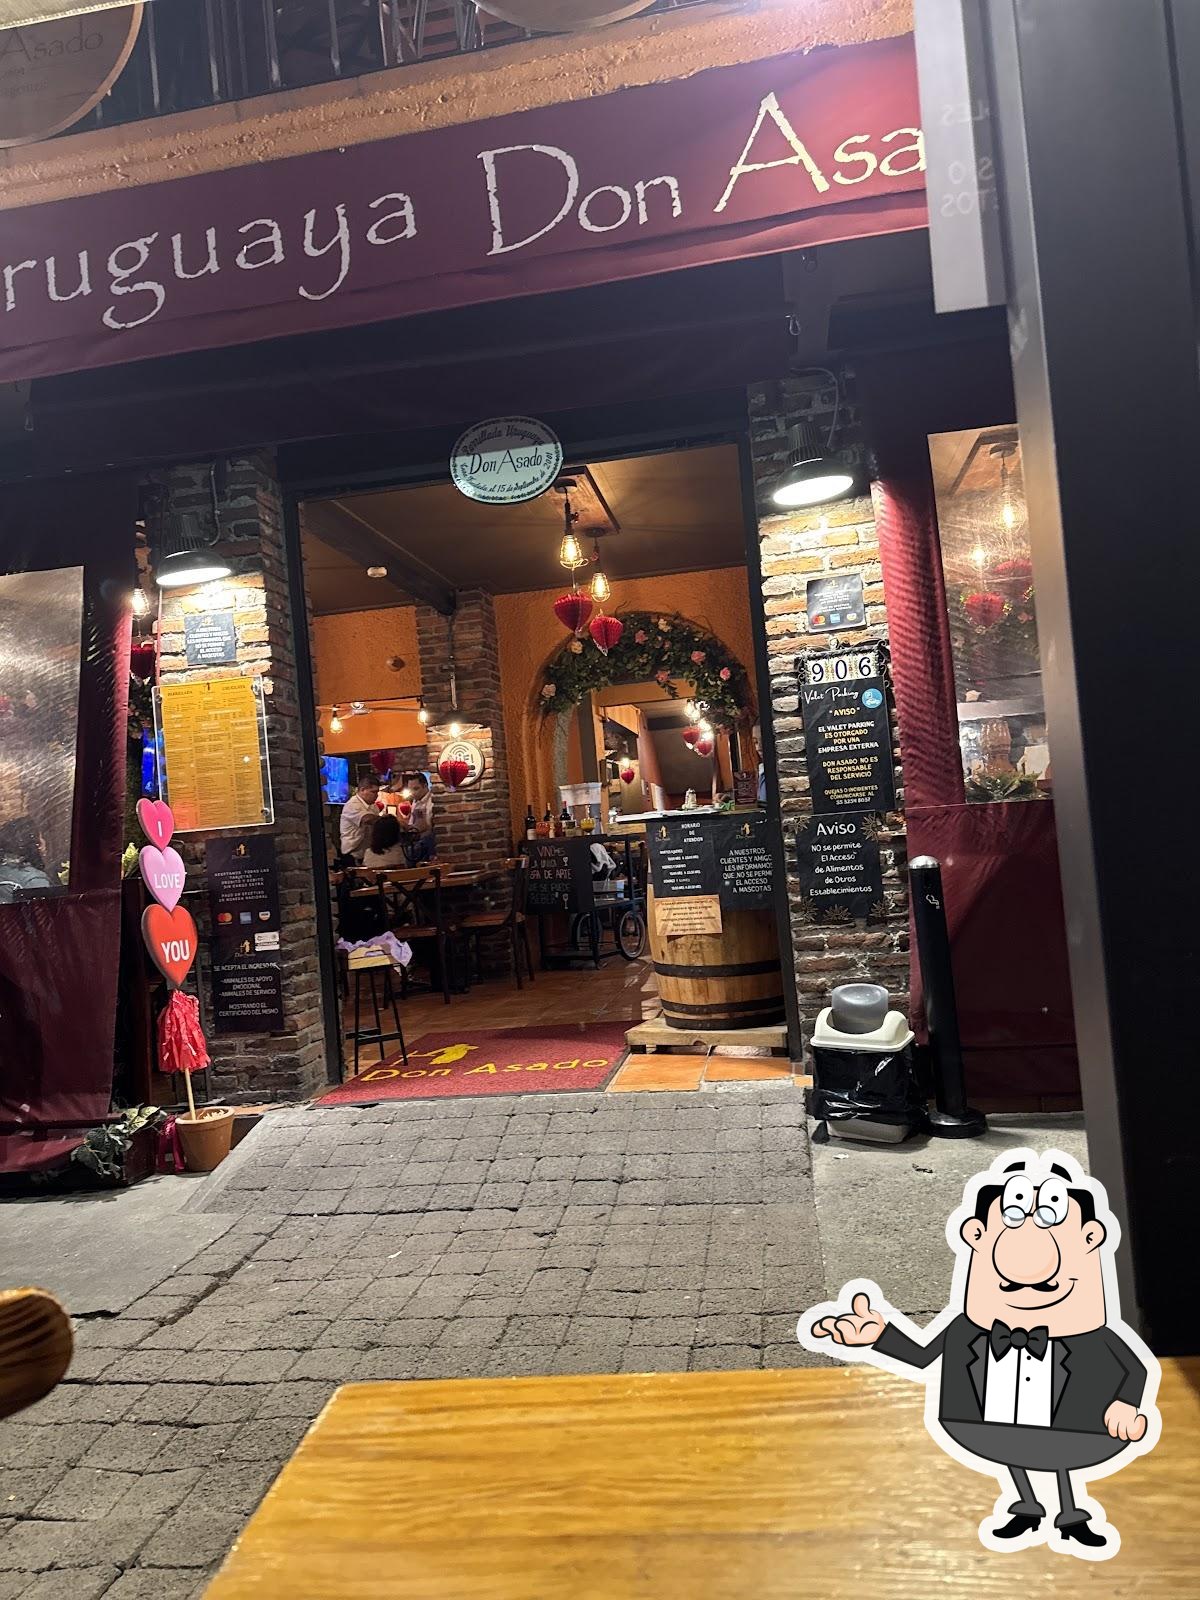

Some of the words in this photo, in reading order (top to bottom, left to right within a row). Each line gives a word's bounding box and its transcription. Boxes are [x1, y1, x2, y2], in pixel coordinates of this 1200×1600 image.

[477, 144, 682, 256] Don
[470, 454, 496, 475] Don
[496, 448, 542, 474] Asado
[498, 484, 506, 492] 15
[812, 657, 872, 682] 906
[848, 721, 874, 730] PARKING
[834, 729, 868, 738] OTORGADO
[818, 745, 848, 754] EMPRESA
[849, 742, 879, 751] EXTERNA
[828, 764, 872, 774] RESPONSABLE
[843, 771, 872, 780] SERVICIO
[157, 821, 162, 837] I
[817, 822, 856, 836] Aviso
[812, 844, 821, 852] NO
[833, 842, 862, 852] permite
[720, 857, 748, 865] CLIENTES
[815, 866, 824, 874] de
[826, 864, 864, 873] Alimentos
[155, 874, 180, 888] LOVE
[739, 885, 772, 893] MASCOTAS
[810, 886, 872, 896] Establecimientos
[161, 940, 190, 963] YOU
[361, 1067, 452, 1082] Don
[464, 1058, 608, 1076] Asado
